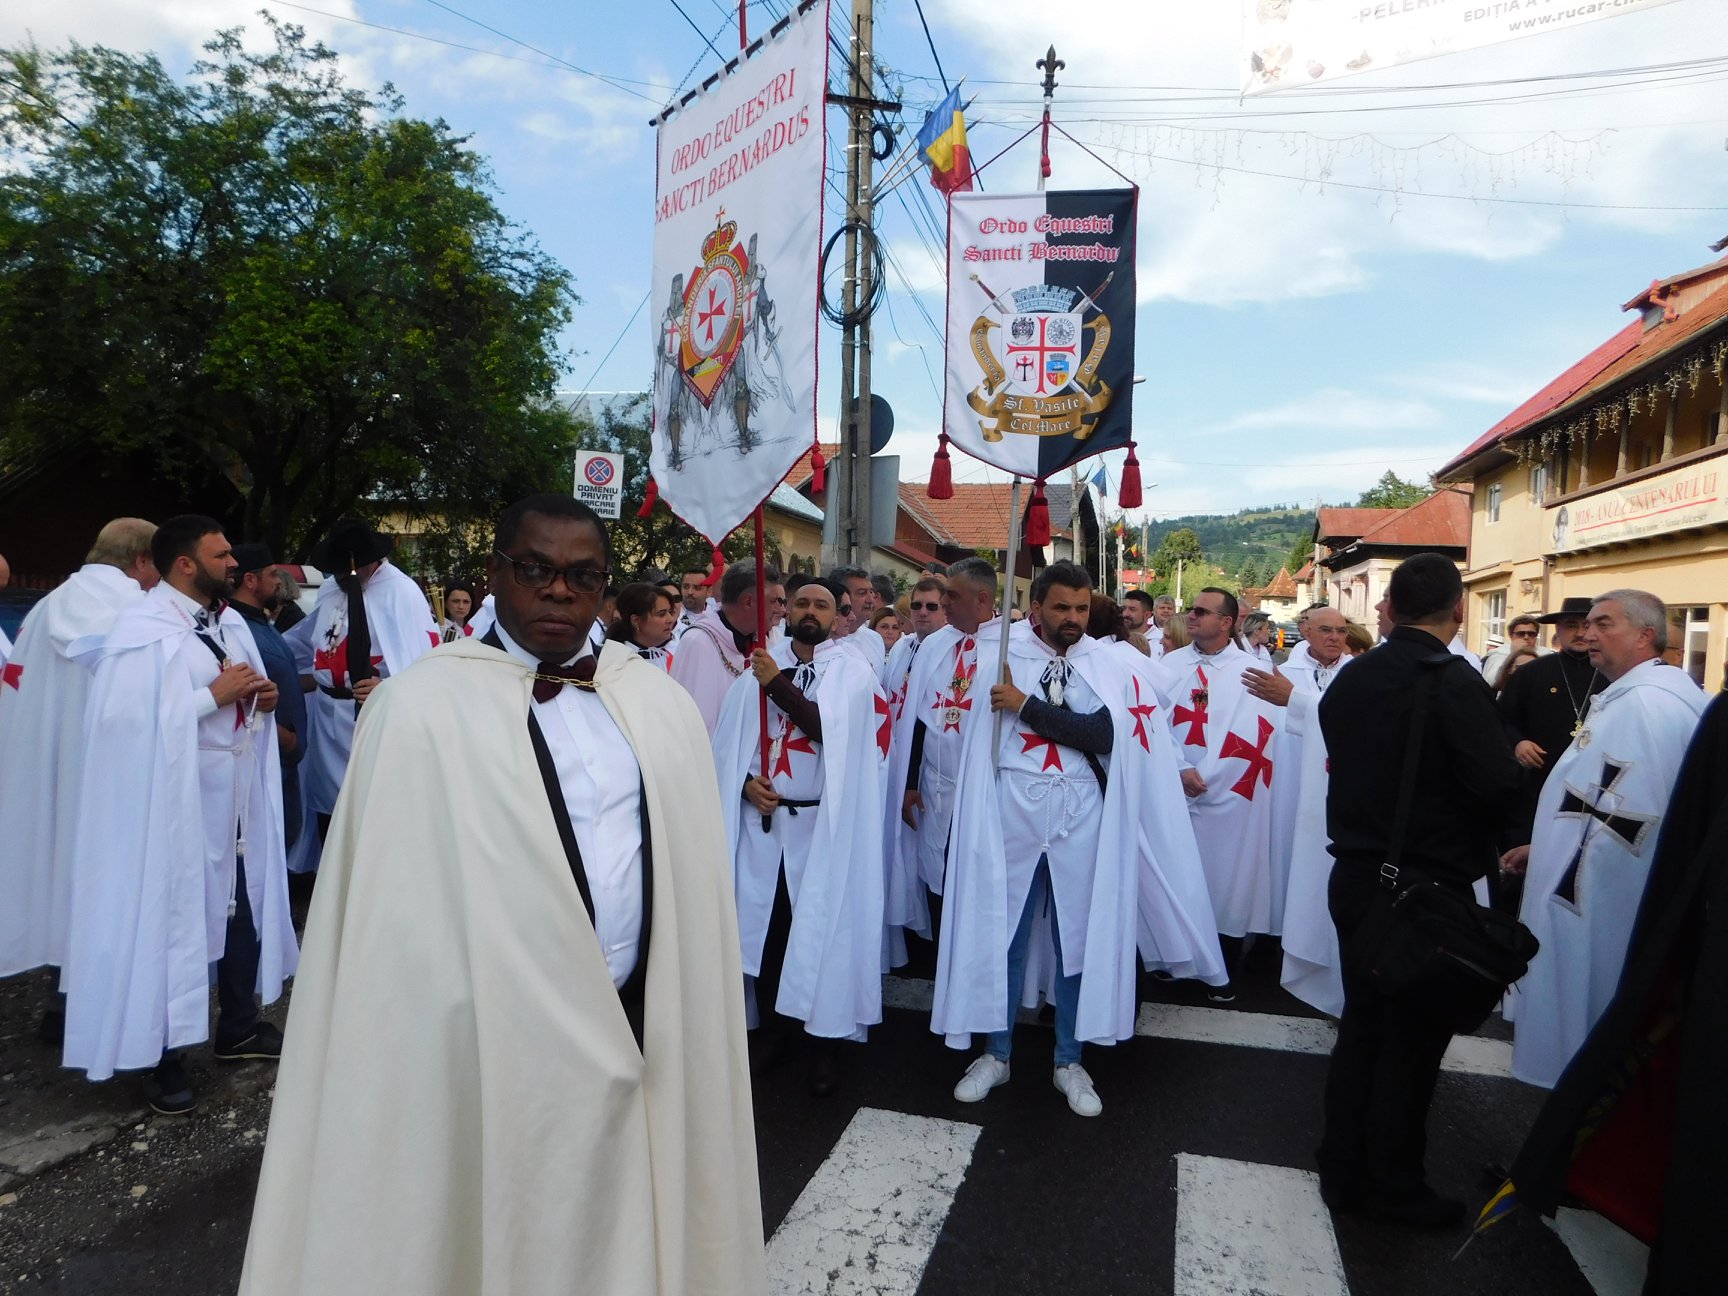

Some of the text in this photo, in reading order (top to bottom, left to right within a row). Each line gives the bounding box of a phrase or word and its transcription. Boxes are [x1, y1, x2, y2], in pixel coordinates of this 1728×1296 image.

[671, 67, 796, 175] ORDO EQUESTRI
[706, 104, 809, 198] BERNARDUS
[979, 213, 1114, 236] Ordo Equestri
[963, 244, 1023, 262] Sancti
[1033, 398, 1080, 413] Vasile
[1010, 418, 1071, 433] Cel Mare
[577, 484, 619, 494] DOMENIU
[580, 491, 615, 501] PRIVAT
